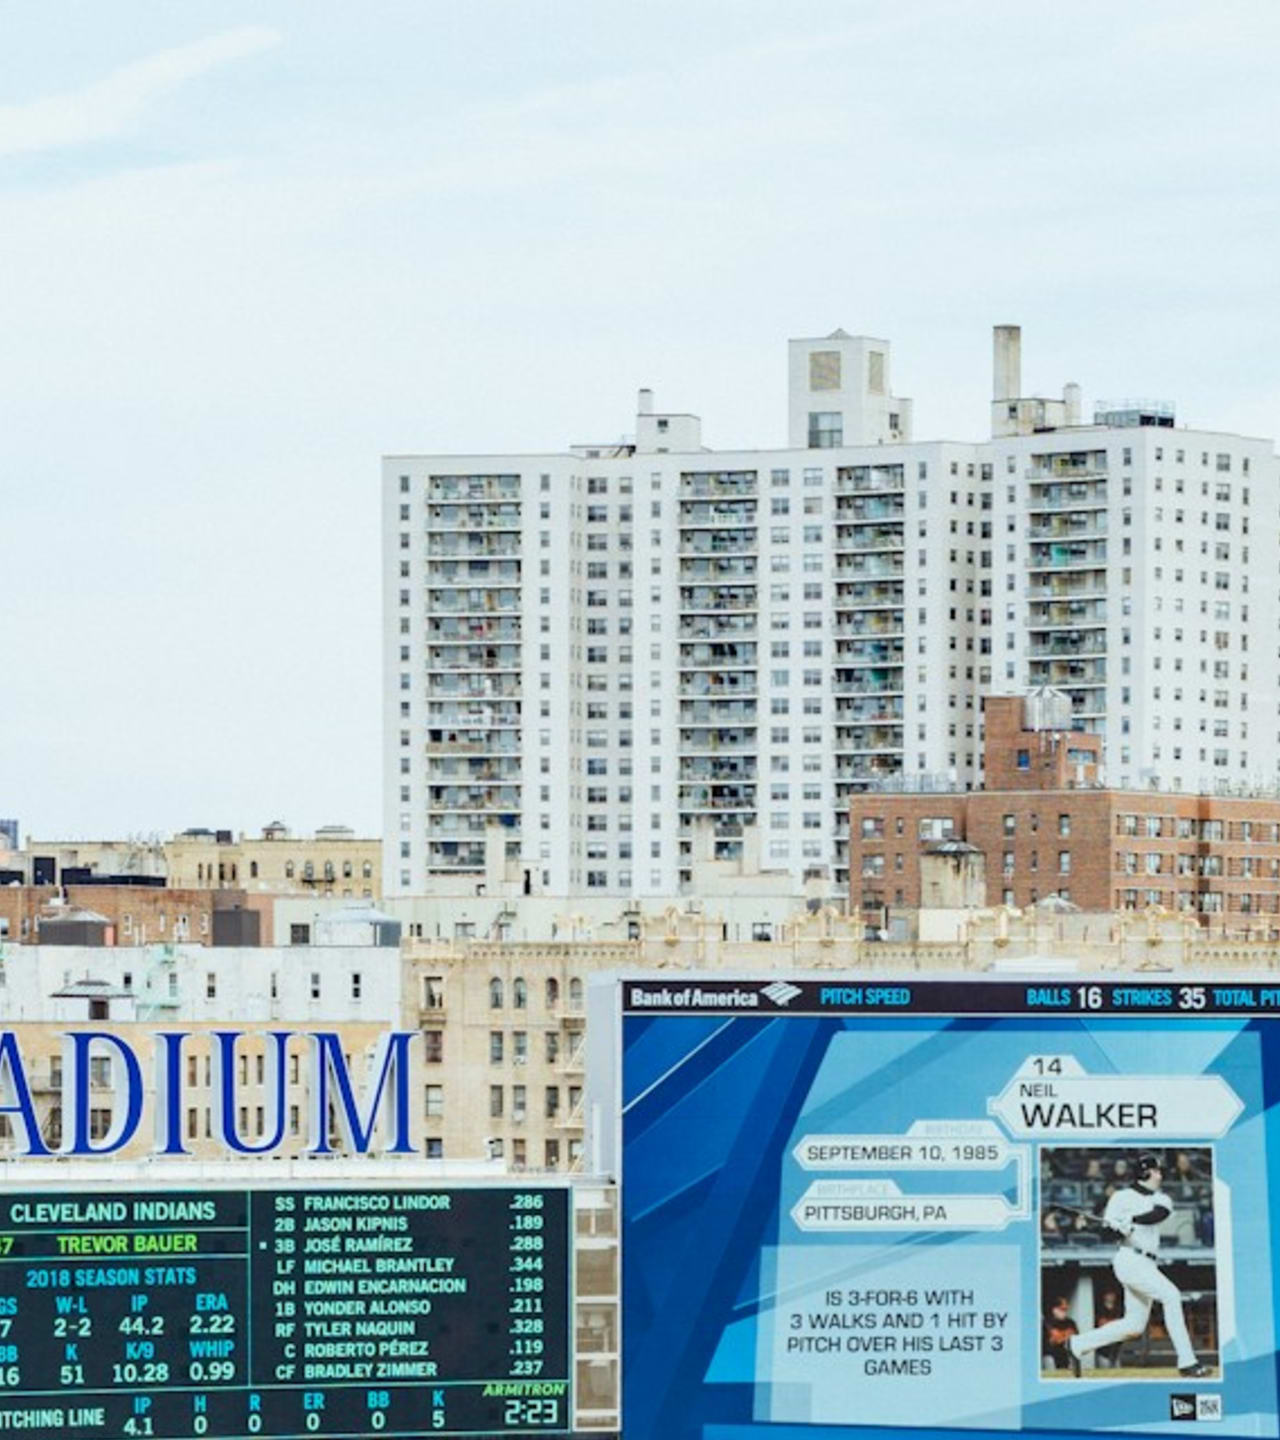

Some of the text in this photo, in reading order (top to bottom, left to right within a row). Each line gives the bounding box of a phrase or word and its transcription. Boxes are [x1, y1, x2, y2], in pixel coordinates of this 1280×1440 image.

[631, 988, 758, 1007] Bank of America
[821, 987, 910, 1005] PITCH SPEED
[1027, 989, 1071, 1006] BALLS
[1078, 987, 1102, 1009] 16
[1112, 989, 1172, 1006] STRIKES
[1179, 987, 1206, 1009] 35
[1213, 989, 1256, 1006] TOTAL
[1033, 1058, 1062, 1075] 14
[1020, 1084, 1058, 1098] NEIL
[1021, 1104, 1157, 1129] WALKER
[808, 1145, 999, 1162] SEPTEMBER 10, 1985
[10, 1202, 216, 1222] CLEVELAND INDIANS
[304, 1195, 451, 1211] FRANCISCO LINDOR
[804, 1206, 947, 1221] PITTSBURGH, PA
[304, 1216, 408, 1232] JASON KIPNIS
[57, 1234, 197, 1253] TREVOR BAUER
[304, 1258, 455, 1274] MICHAEL BRANTLEY
[26, 1268, 196, 1288] 2018 SEASON STATS
[112, 1364, 168, 1382] 10.28
[505, 1399, 558, 1423] 2:23
